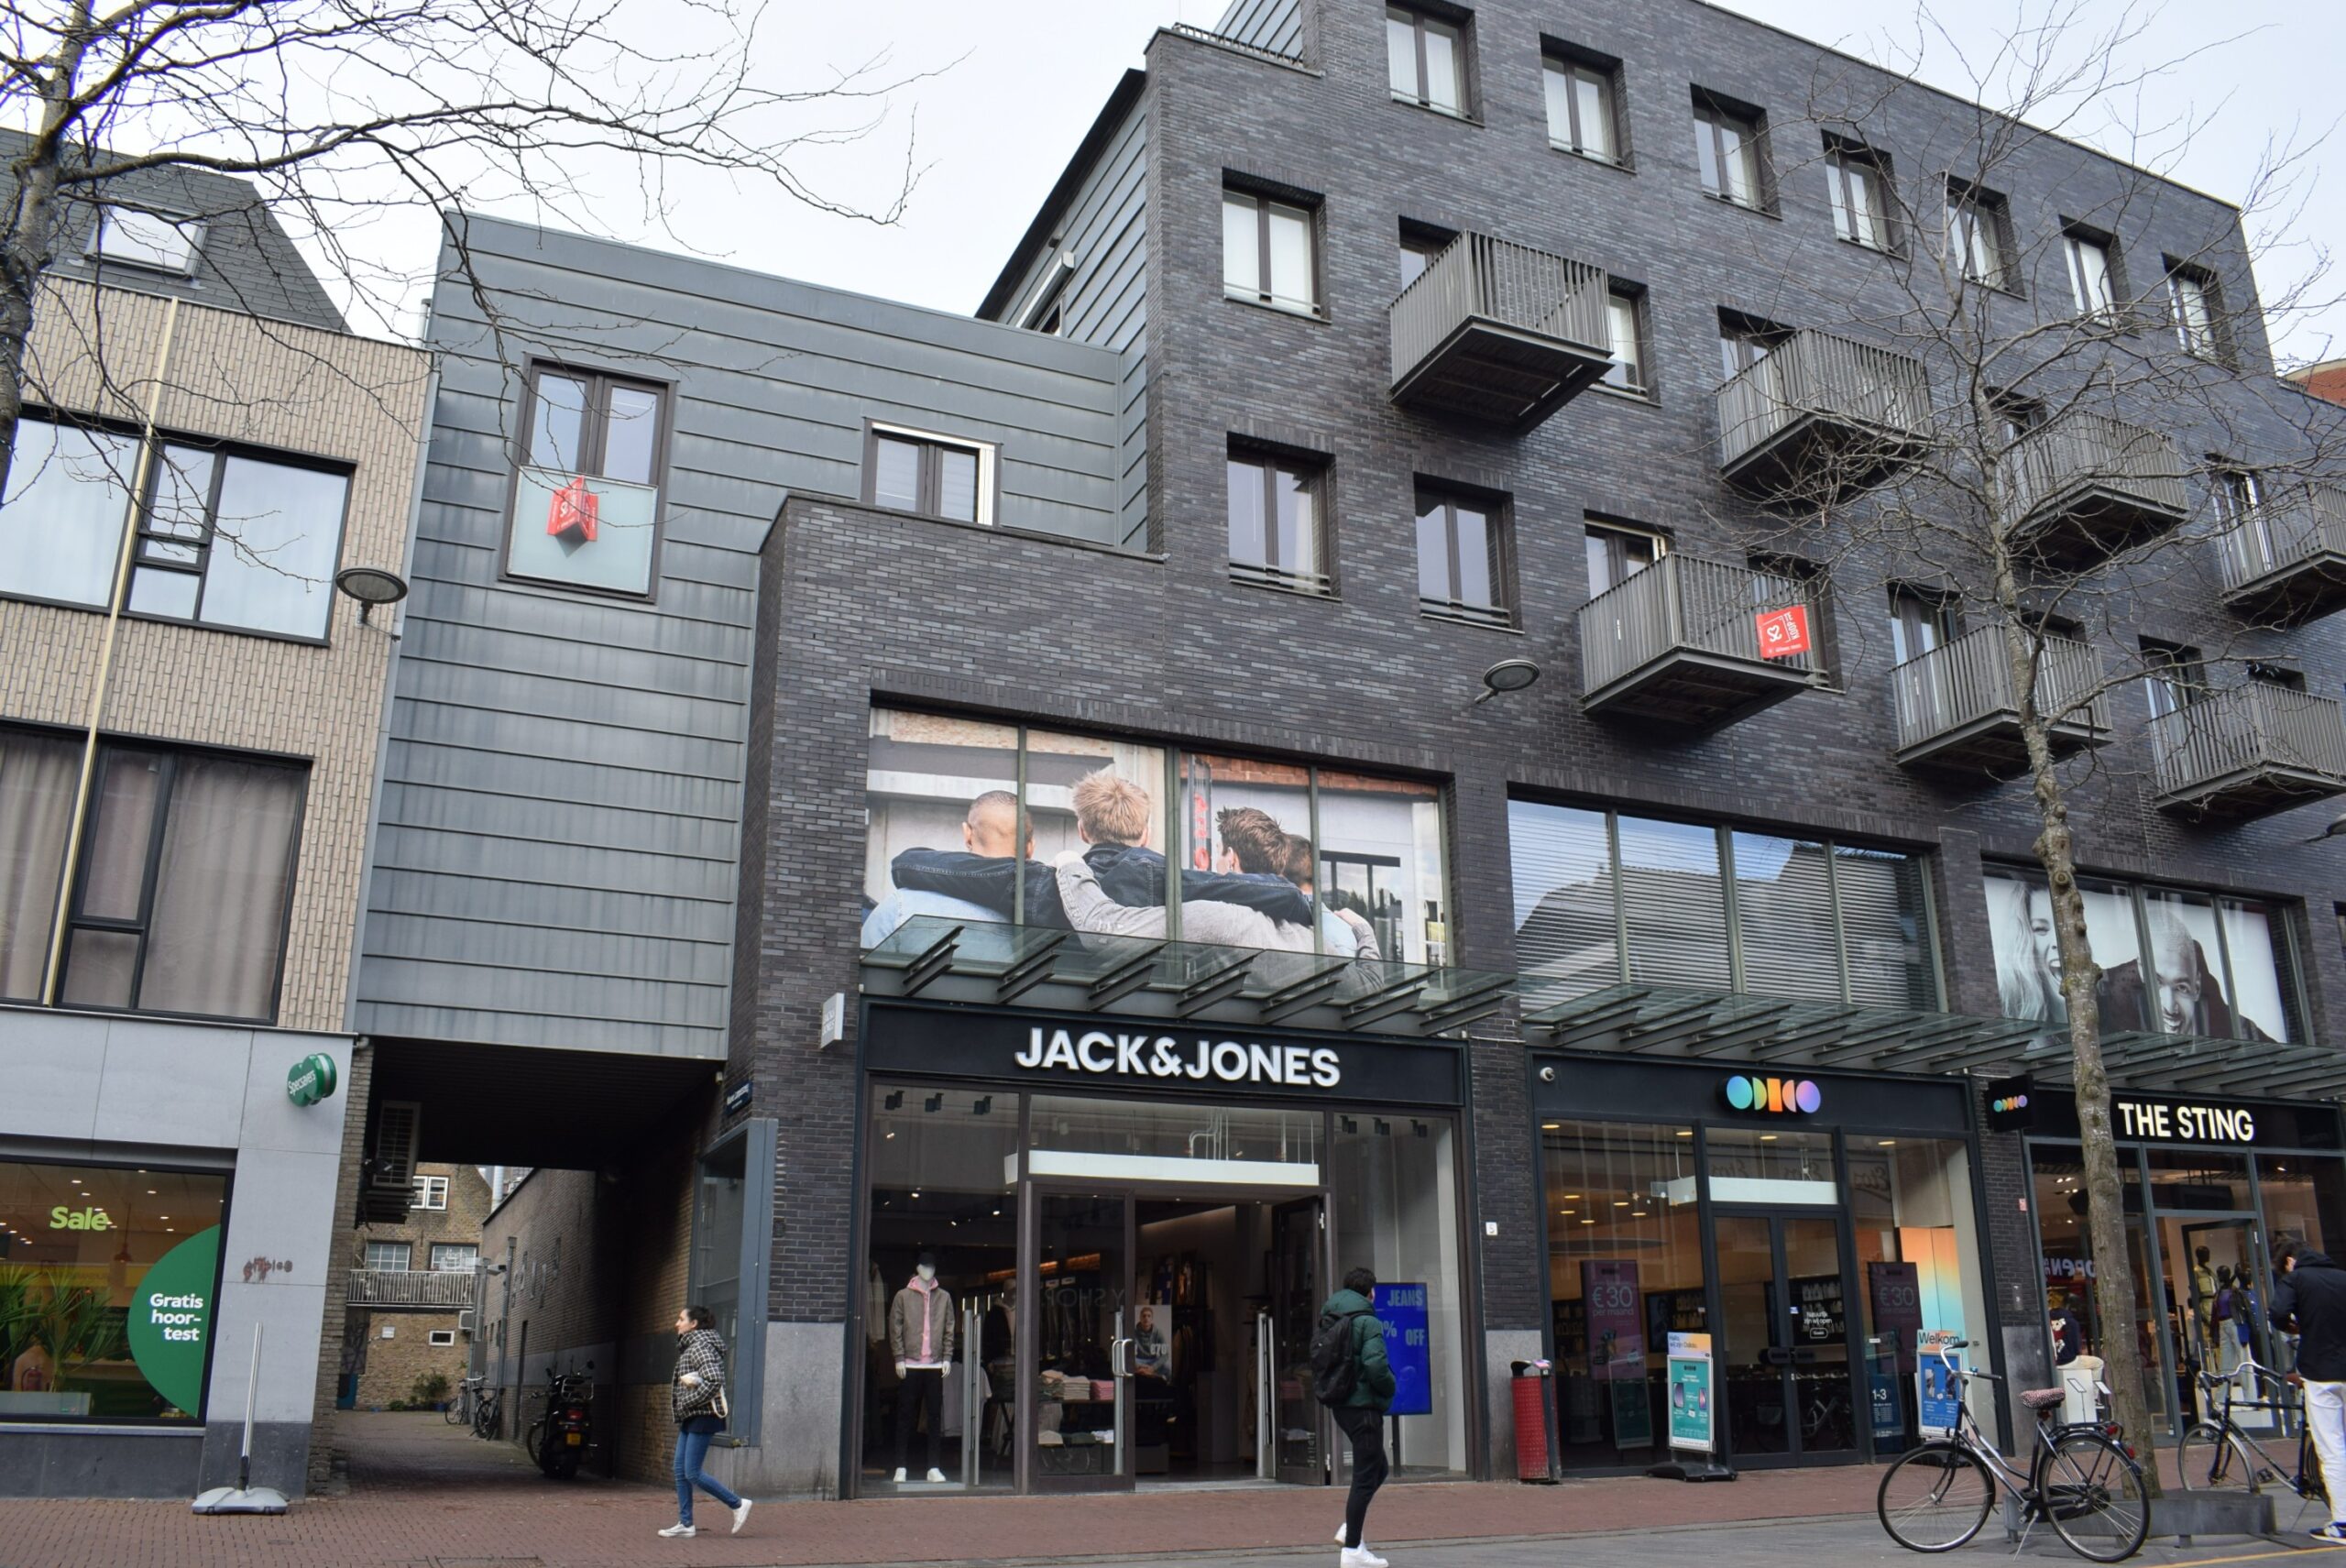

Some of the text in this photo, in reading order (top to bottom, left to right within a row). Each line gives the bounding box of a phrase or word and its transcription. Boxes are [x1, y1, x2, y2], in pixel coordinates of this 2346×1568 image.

[1014, 1027, 1341, 1087] JACK&JONES
[289, 1069, 315, 1096] Specsavers
[2118, 1102, 2254, 1141] THE STING
[49, 1206, 109, 1231] Sale
[149, 1293, 203, 1309] Gratis
[1387, 1289, 1423, 1307] JEANS
[150, 1310, 202, 1324] hoor-
[163, 1326, 200, 1342] test
[1405, 1328, 1425, 1346] OFF
[1919, 1332, 1960, 1345] Welkom
[1872, 1388, 1888, 1400] 1-3
